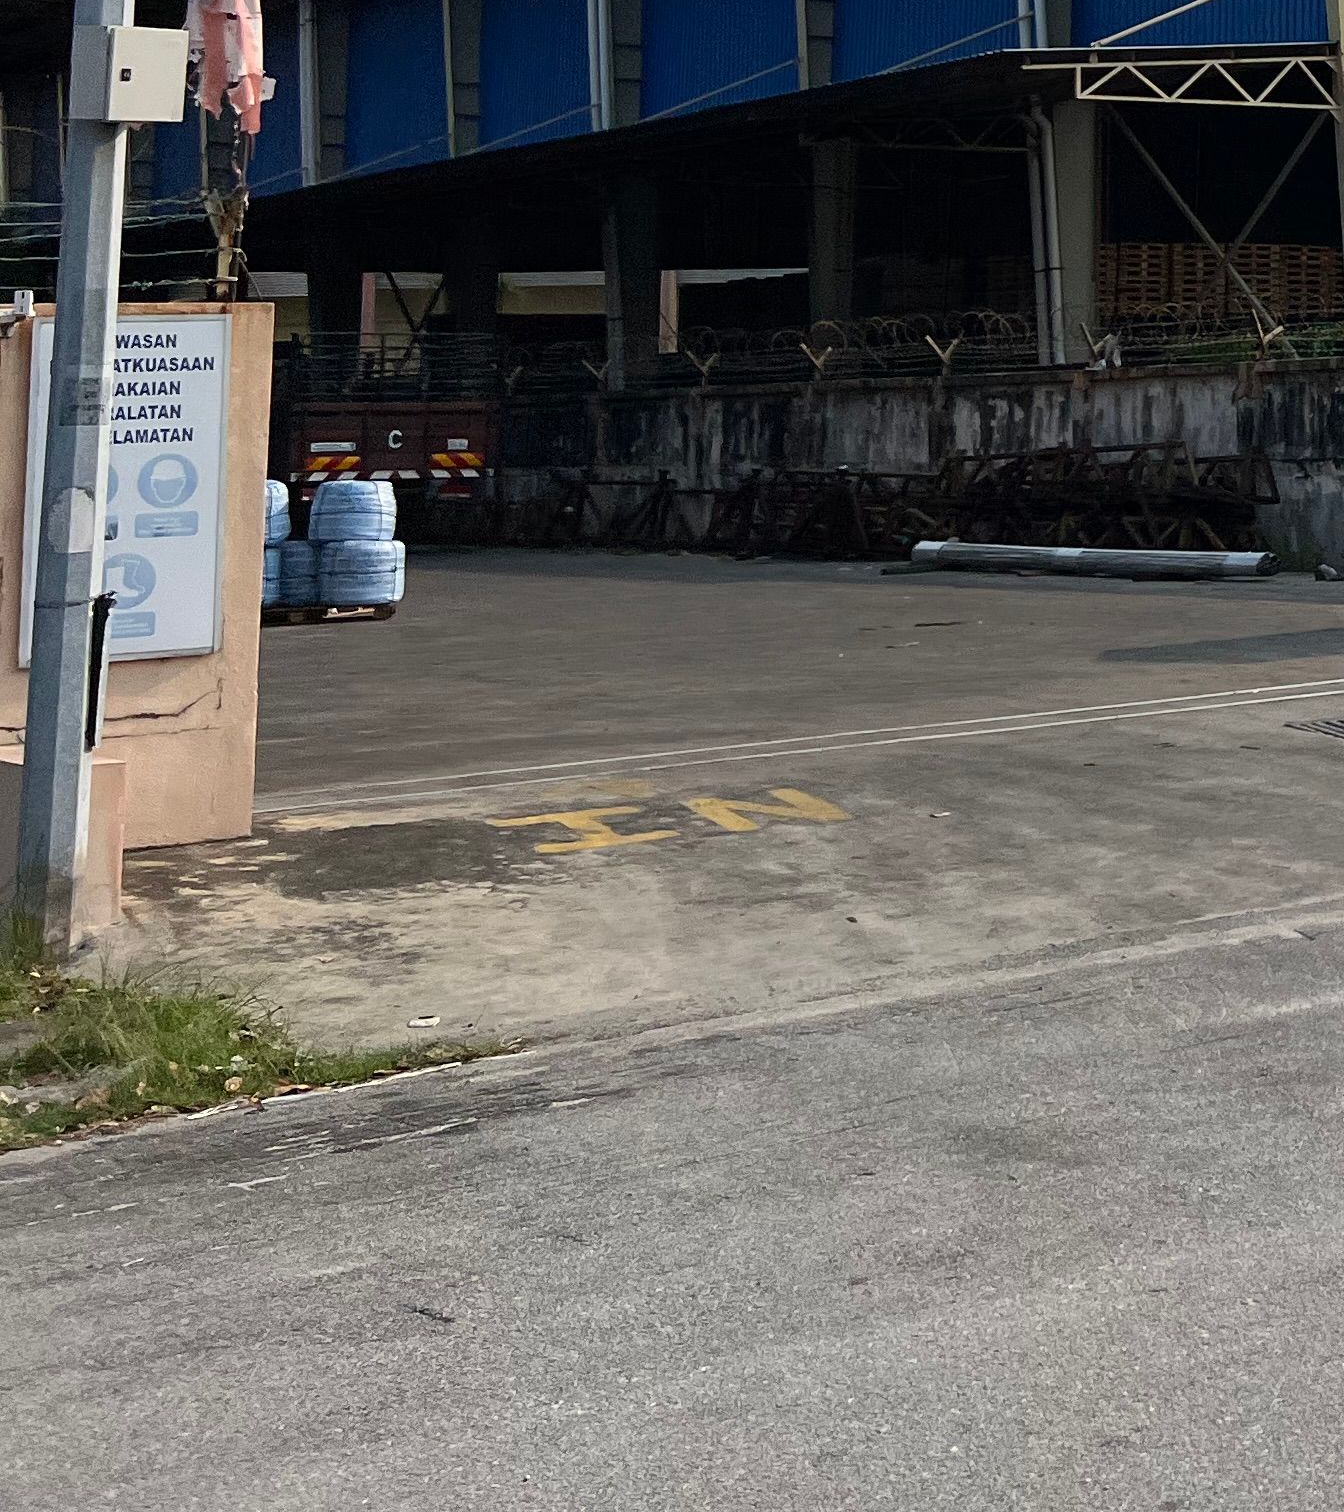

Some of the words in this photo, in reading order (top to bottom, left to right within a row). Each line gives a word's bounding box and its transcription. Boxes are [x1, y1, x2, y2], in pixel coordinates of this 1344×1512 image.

[115, 334, 177, 349] WASAN
[113, 357, 215, 373] ATKUASAAN
[112, 381, 181, 397] AKAIAN
[110, 405, 182, 421] ALATAN
[109, 428, 194, 445] LAMATAN
[388, 429, 403, 449] C
[484, 787, 856, 855] IN
